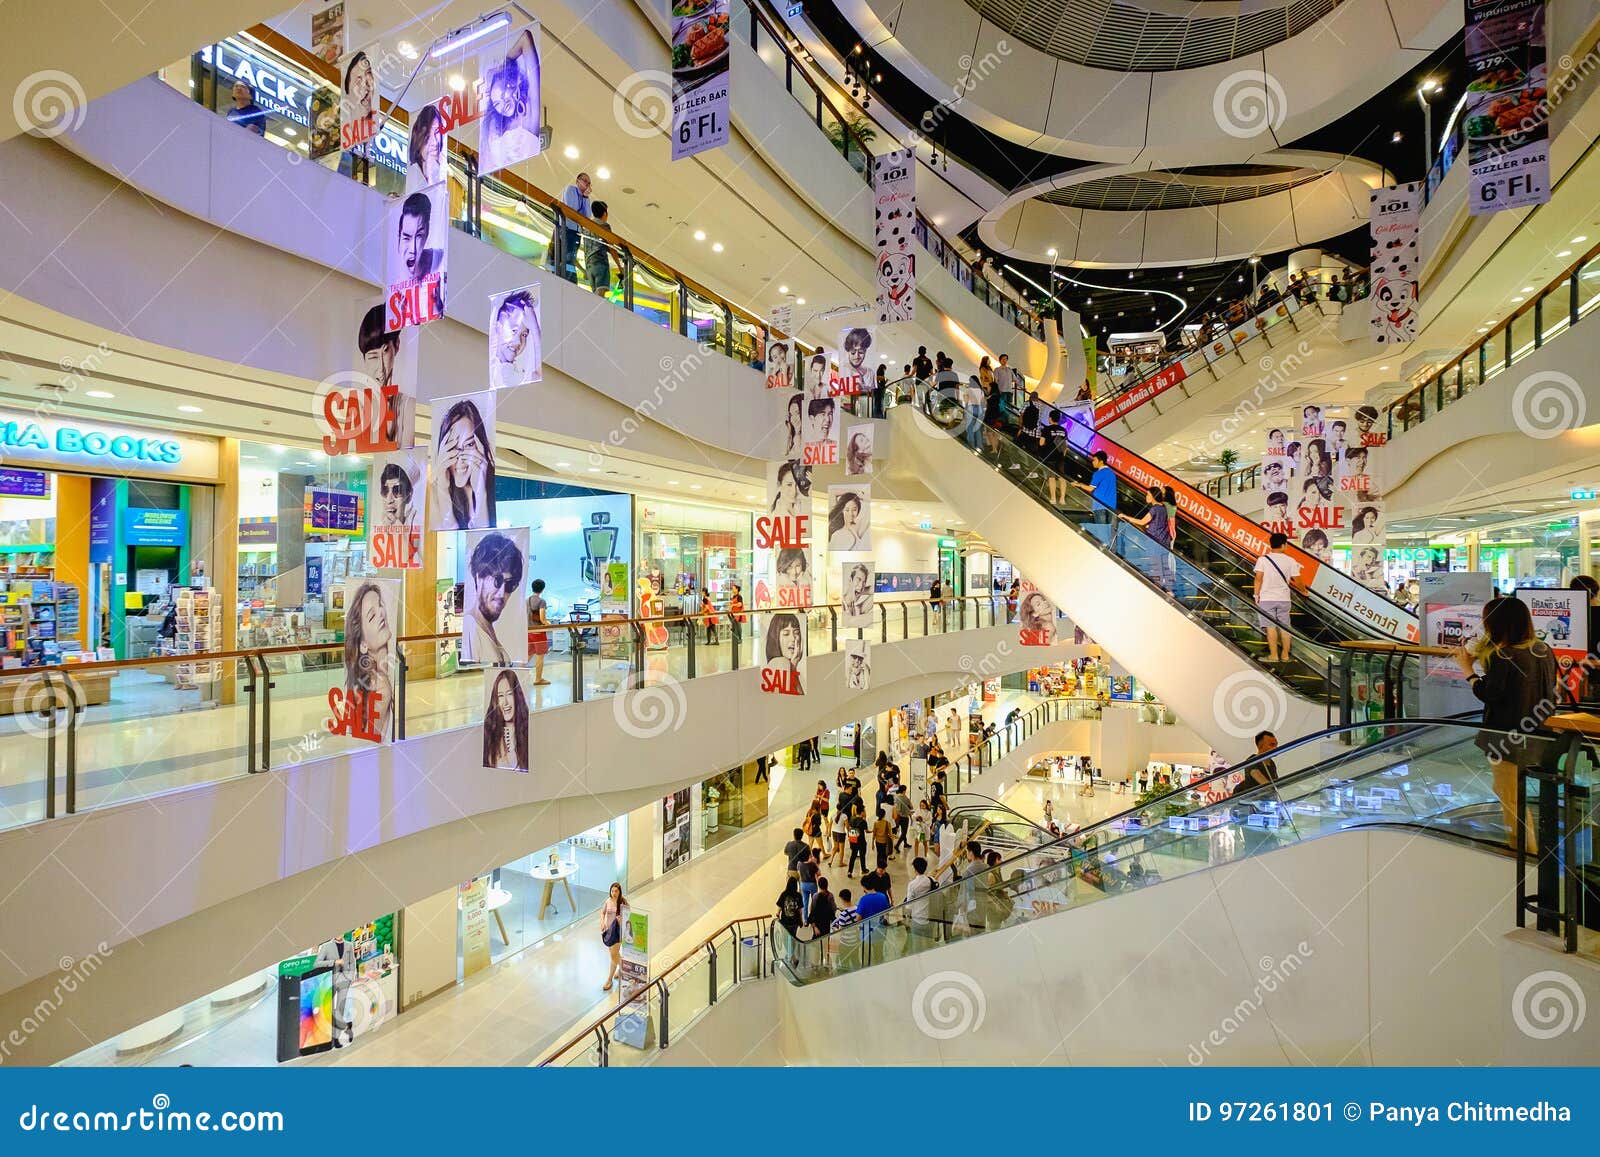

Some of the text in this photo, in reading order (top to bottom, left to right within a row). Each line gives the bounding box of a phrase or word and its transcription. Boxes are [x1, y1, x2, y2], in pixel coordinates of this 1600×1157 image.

[437, 80, 484, 134] SALE
[674, 96, 706, 114] SIZZLER
[709, 89, 727, 102] BAR
[342, 110, 377, 150] SALE
[883, 167, 907, 182] 101
[1472, 159, 1519, 177] SIZZLER
[1522, 155, 1546, 166] BAR
[1380, 201, 1409, 213] 101
[389, 282, 440, 331] SALE
[767, 372, 793, 389] SALE
[828, 373, 862, 398] SALE
[323, 384, 399, 456] SALE
[56, 427, 182, 463] BOOKS
[1267, 446, 1286, 457] SALE
[1359, 432, 1387, 448] SALE
[803, 445, 837, 465] SALE
[1340, 477, 1371, 491] SALE
[1298, 506, 1345, 529] SALE
[755, 515, 809, 549] SALE
[373, 533, 421, 569] SALE
[778, 586, 812, 607] SALE
[1019, 629, 1051, 647] SALE
[761, 667, 805, 696] SALE
[327, 687, 383, 744] SALE
